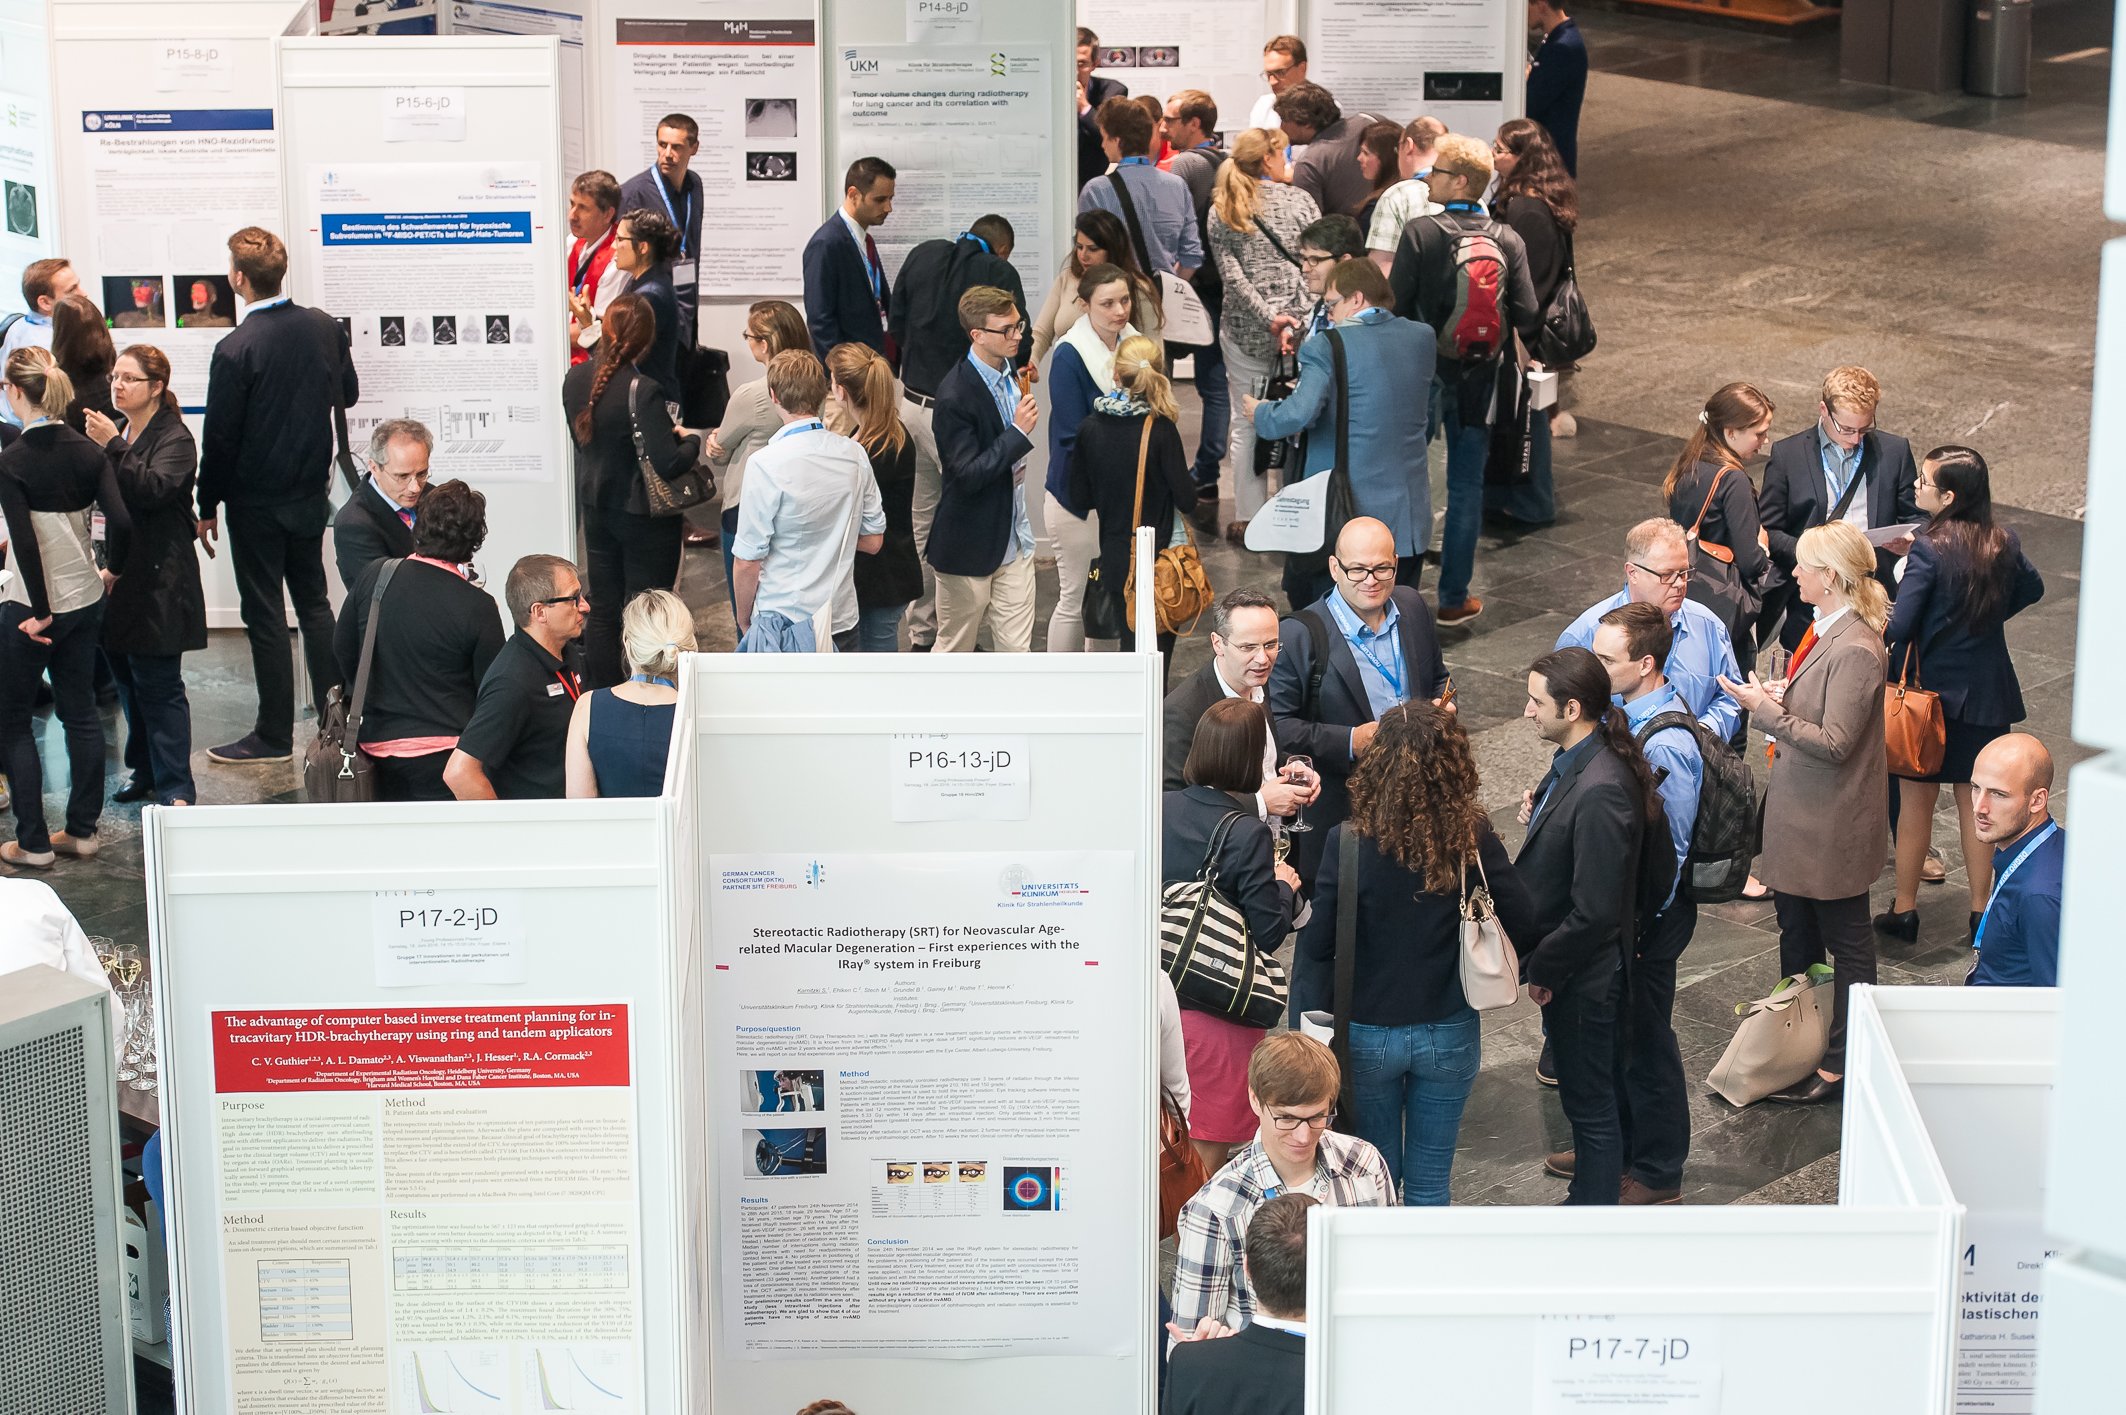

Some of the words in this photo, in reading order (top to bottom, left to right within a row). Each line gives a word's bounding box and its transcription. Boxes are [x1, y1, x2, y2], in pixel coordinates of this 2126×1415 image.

[920, 2, 968, 14] P14-8-jD
[167, 49, 218, 62] P15-8-jD
[850, 60, 878, 72] UKM
[912, 90, 946, 99] changes
[949, 90, 975, 99] during
[977, 90, 1029, 99] radiotherapy
[396, 97, 450, 110] P15-6-jD
[866, 100, 884, 109] lung
[909, 750, 1011, 772] P16-13-jD
[400, 906, 498, 930] P17-2-jD
[752, 927, 823, 936] Stereotactic
[826, 926, 906, 938] Radiotherapy
[909, 926, 939, 938] (SRT)
[942, 926, 959, 935] for
[963, 924, 1035, 934] Neovascular
[1038, 924, 1064, 934] Age-
[738, 944, 780, 954] related
[784, 942, 832, 952] Macular
[836, 942, 914, 954] Degeneration
[929, 942, 953, 951] First
[957, 942, 1027, 952] experiences
[1030, 940, 1056, 948] with
[1060, 940, 1079, 948] the
[838, 959, 870, 970] IRay®
[873, 960, 914, 970] system
[918, 958, 928, 968] in
[932, 958, 980, 969] Freiburg
[225, 1016, 246, 1026] The
[249, 1015, 308, 1028] advantage
[310, 1014, 324, 1024] of
[325, 1016, 381, 1027] computer
[384, 1012, 417, 1024] based
[420, 1013, 462, 1023] inverse
[464, 1012, 521, 1022] treatment
[524, 1010, 576, 1024] planning
[579, 1010, 596, 1020] for
[598, 1010, 616, 1020] in-
[230, 1032, 292, 1045] tracavitary
[295, 1029, 413, 1044] HDR-brachytherapy
[416, 1029, 448, 1042] using
[450, 1028, 475, 1042] ring
[477, 1027, 499, 1038] and
[502, 1026, 546, 1038] tandem
[549, 1025, 612, 1040] applicators
[252, 1058, 262, 1066] C.
[264, 1058, 272, 1066] V.
[326, 1056, 336, 1064] A.
[338, 1056, 346, 1064] L.
[396, 1056, 406, 1064] A.
[476, 1054, 482, 1062] J.
[222, 1100, 265, 1112] Purpose
[385, 1098, 426, 1108] Method
[224, 1215, 264, 1225] Method
[390, 1210, 426, 1220] Results
[1962, 1308, 2038, 1319] lastischen
[1570, 1338, 1690, 1366] P17-7-jD
